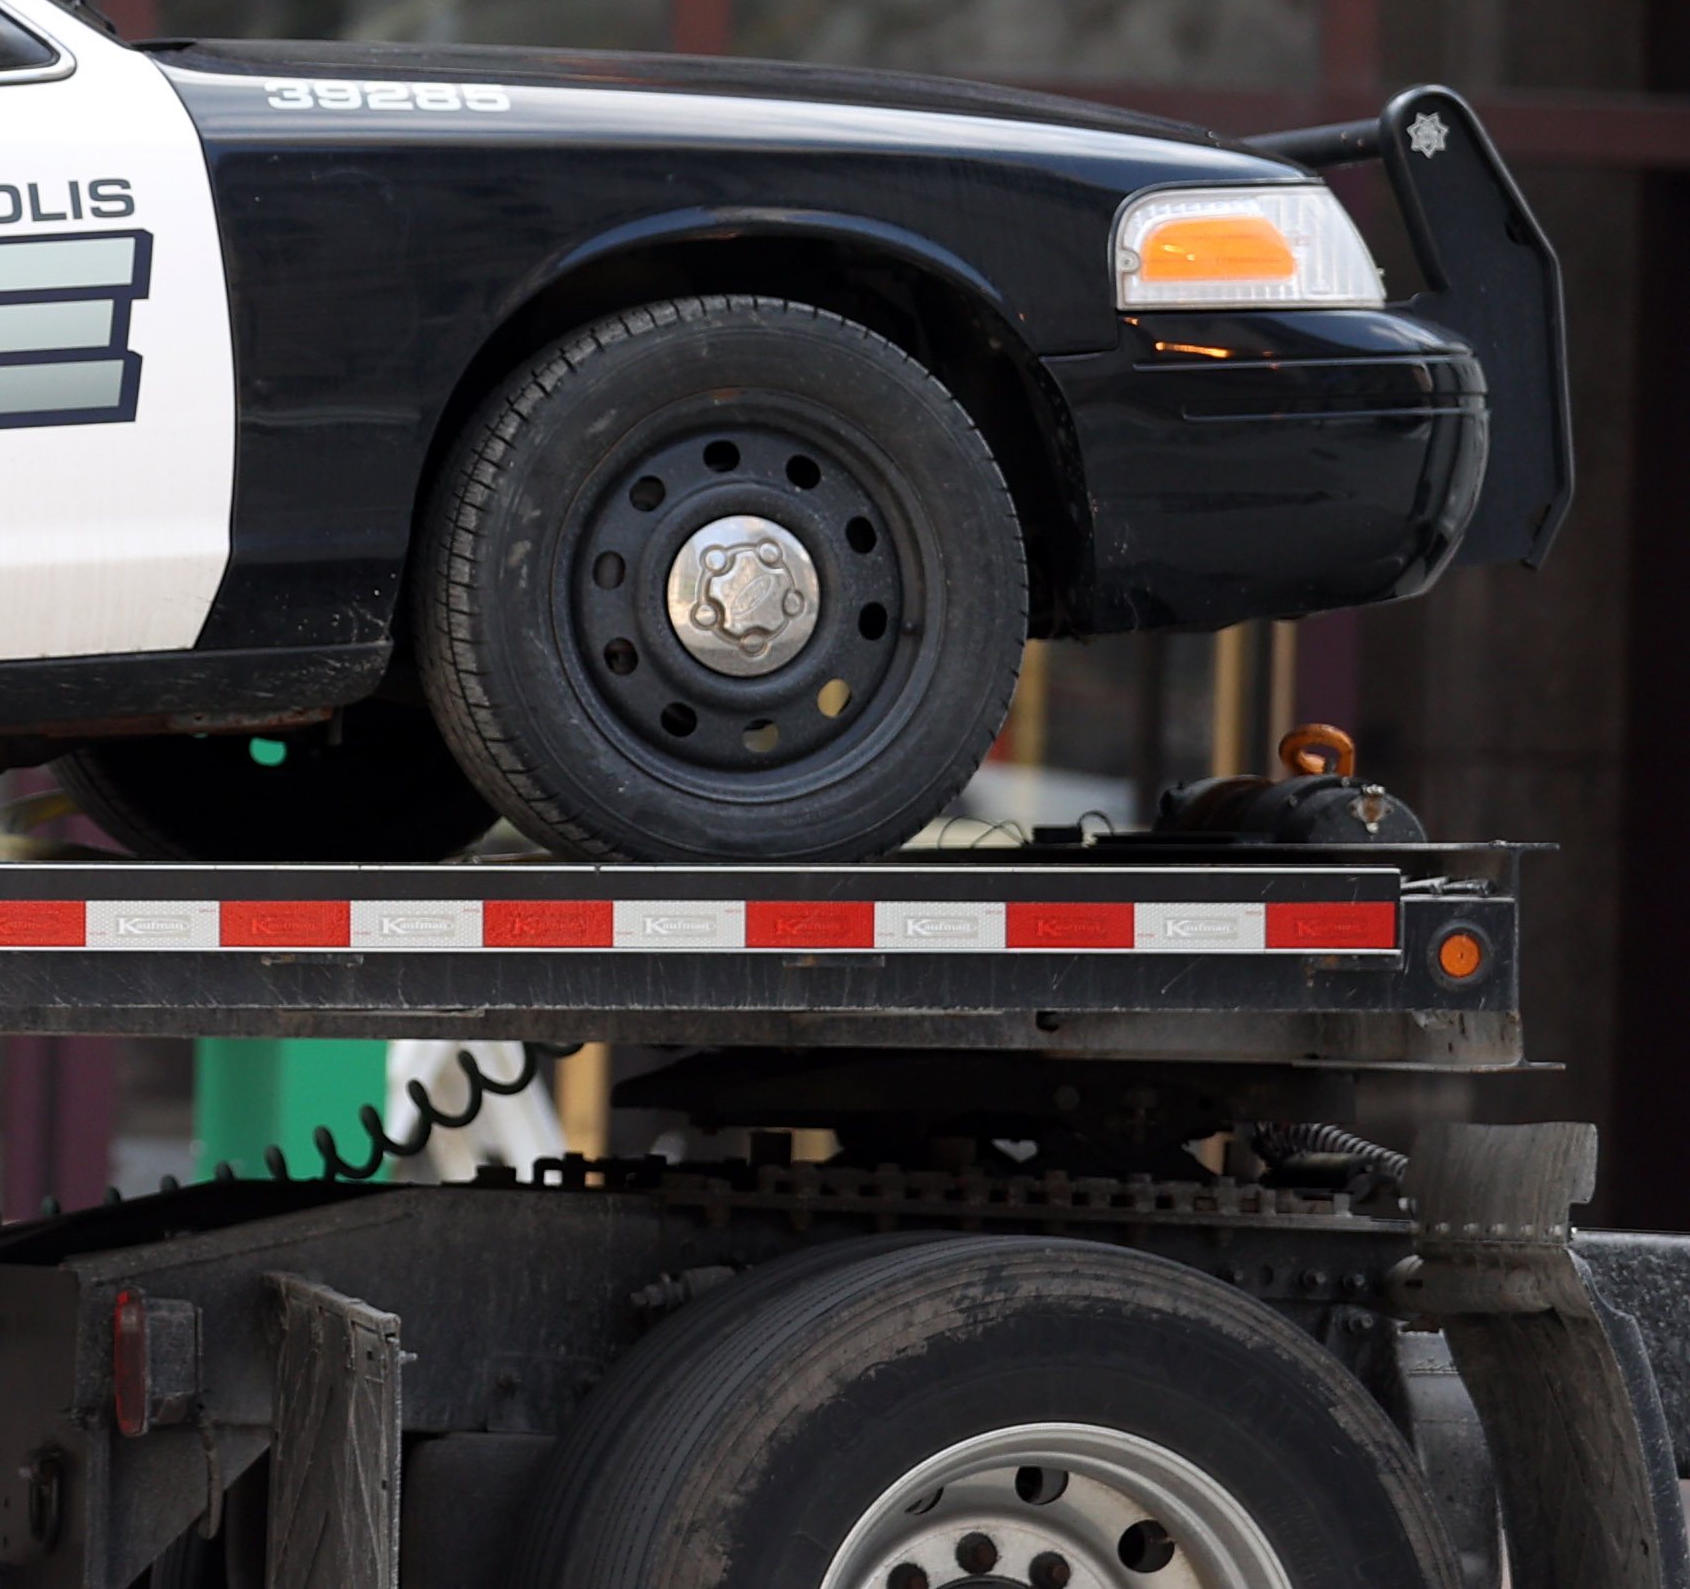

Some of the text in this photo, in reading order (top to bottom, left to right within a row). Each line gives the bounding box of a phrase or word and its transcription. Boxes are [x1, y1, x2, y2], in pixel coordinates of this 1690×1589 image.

[264, 79, 511, 112] 39285
[116, 916, 185, 934] Kaufman
[380, 916, 449, 934] Kaufman
[643, 916, 711, 934] Kaufman
[906, 917, 971, 936] Kaufman
[1165, 918, 1230, 937] Kaufman
